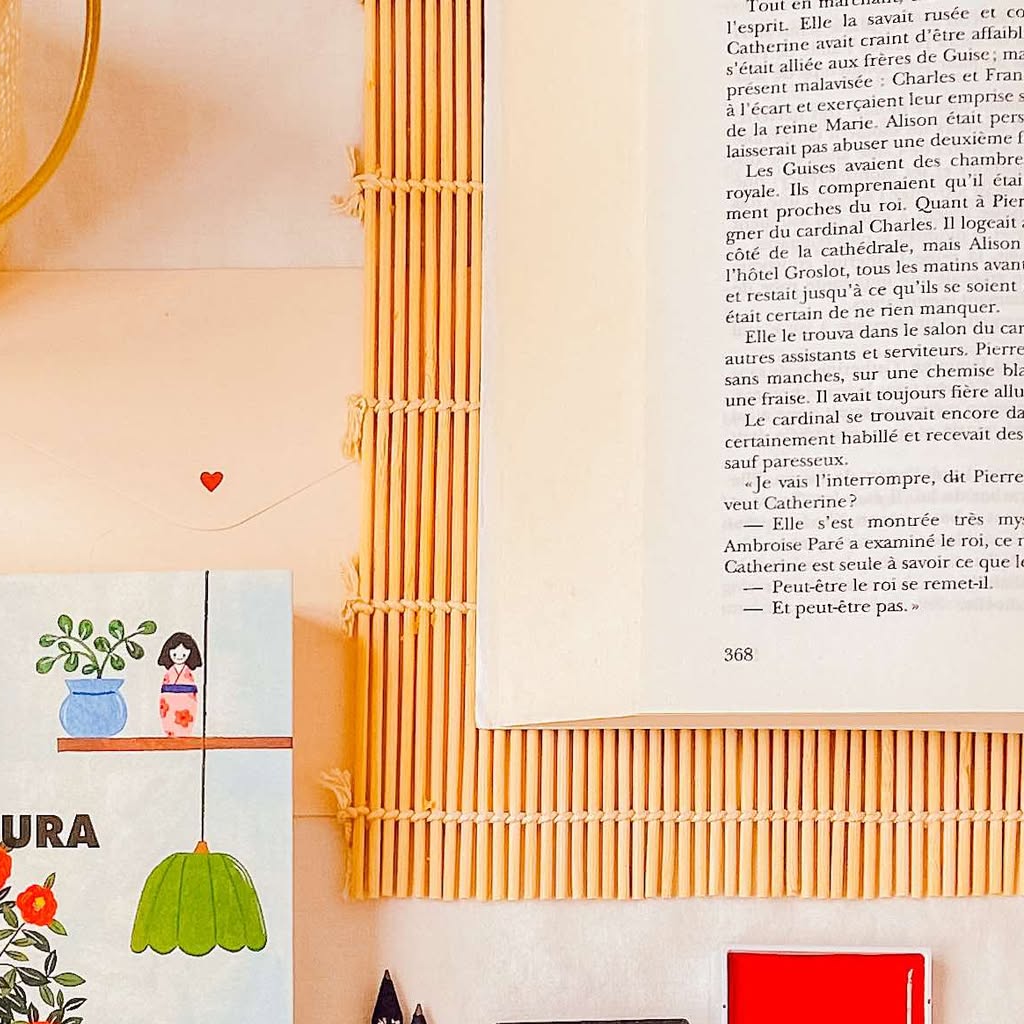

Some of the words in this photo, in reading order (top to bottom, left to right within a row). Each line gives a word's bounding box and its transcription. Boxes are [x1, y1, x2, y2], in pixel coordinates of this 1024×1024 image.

[800, 15, 832, 31] Elle
[843, 13, 857, 28] la
[868, 9, 914, 26] savait
[925, 5, 970, 22] rusée
[981, 8, 996, 20] et
[727, 39, 809, 55] Catherine
[816, 34, 854, 50] avait
[861, 32, 909, 47] craint
[915, 28, 965, 43] d'être
[726, 60, 774, 76] s'était
[780, 56, 822, 73] alliée
[828, 58, 859, 70] aux
[864, 51, 911, 67] frères
[917, 50, 937, 64] de
[727, 81, 787, 101] présent
[795, 74, 872, 93] malavisée
[892, 69, 955, 87] Charles
[963, 71, 978, 83] et
[740, 102, 792, 117] l'écart
[797, 101, 812, 113] et
[817, 94, 904, 112] exerçaient
[909, 91, 943, 106] leur
[948, 88, 1013, 108] emprise
[727, 123, 746, 138] de
[754, 122, 767, 137] la
[776, 121, 817, 136] reine
[886, 113, 937, 129] Alison
[946, 110, 981, 125] était
[726, 141, 797, 158] laisserait
[802, 143, 828, 159] pas
[833, 137, 888, 153] abuser
[893, 137, 924, 149] une
[930, 131, 1012, 147] deuxième
[746, 163, 773, 178] Les
[783, 160, 835, 176] Guises
[845, 157, 904, 172] avaient
[913, 154, 940, 169] des
[790, 182, 809, 196] Ils
[819, 175, 936, 198] comprenaient
[945, 173, 983, 193] qu'il
[726, 208, 768, 220] ment
[777, 202, 841, 223] proches
[849, 199, 871, 214] du
[915, 195, 968, 214] Quant
[726, 229, 764, 245] gner
[769, 224, 790, 239] du
[797, 219, 863, 238] cardinal
[944, 216, 954, 230] Il
[961, 214, 1016, 234] logeait
[726, 246, 760, 262] côté
[769, 245, 788, 260] de
[798, 244, 812, 259] la
[821, 239, 913, 257] cathédrale,
[923, 237, 960, 252] mais
[726, 266, 778, 282] l'hôtel
[785, 263, 850, 280] Groslot,
[857, 264, 890, 277] tous
[896, 260, 917, 275] les
[924, 257, 978, 273] matins
[726, 291, 742, 304] et
[746, 287, 798, 303] restait
[799, 283, 863, 305] jusqu'à
[869, 286, 887, 297] ce
[893, 279, 938, 300] qu'ils
[944, 283, 960, 293] se
[967, 278, 1017, 293] soient
[726, 309, 761, 324] était
[766, 307, 822, 323] certain
[829, 305, 849, 320] de
[855, 307, 875, 318] ne
[881, 303, 913, 317] rien
[745, 329, 776, 344] Elle
[782, 328, 796, 343] le
[803, 329, 854, 341] trouva
[860, 324, 898, 339] dans
[904, 322, 918, 337] le
[923, 321, 966, 337] salon
[973, 320, 994, 336] du
[725, 354, 775, 365] autres
[781, 348, 856, 363] assistants
[863, 348, 878, 360] et
[725, 374, 759, 387] sans
[767, 368, 844, 385] manches,
[853, 370, 879, 382] sur
[887, 368, 918, 380] une
[927, 363, 994, 379] chemise
[726, 396, 756, 407] une
[816, 389, 827, 404] Il
[833, 388, 871, 404] avait
[877, 386, 945, 405] toujours
[951, 384, 988, 399] fière
[745, 413, 765, 428] Le
[773, 410, 839, 426] cardinal
[846, 413, 863, 423] se
[871, 407, 935, 423] trouvait
[942, 409, 999, 420] encore
[725, 434, 835, 449] certainement
[841, 428, 898, 445] habillé
[905, 431, 920, 443] et
[926, 426, 990, 442] recevait
[724, 454, 759, 470] sauf
[778, 474, 808, 489] vais
[816, 473, 935, 489] l'interrompre,
[723, 499, 759, 511] veut
[773, 516, 804, 531] Elle
[818, 515, 854, 530] s'est
[868, 512, 939, 529] montrée
[955, 512, 983, 526] très
[724, 538, 802, 554] Ambroise
[808, 537, 844, 551] Paré
[865, 533, 935, 550] examiné
[941, 533, 955, 548] le
[961, 533, 988, 550] roi,
[995, 536, 1012, 548] ce
[725, 558, 806, 574] Catherine
[812, 560, 835, 572] est
[839, 556, 882, 572] seule
[902, 554, 951, 570] savoir
[956, 558, 973, 569] ce
[979, 558, 1010, 574] que
[772, 578, 847, 594] Peut-être
[853, 578, 867, 592] le
[873, 578, 896, 592] roi
[901, 580, 918, 591] se
[924, 575, 993, 591] remet-il.
[772, 600, 790, 615] Et
[795, 599, 871, 620] peut-être
[724, 646, 753, 662] 368
